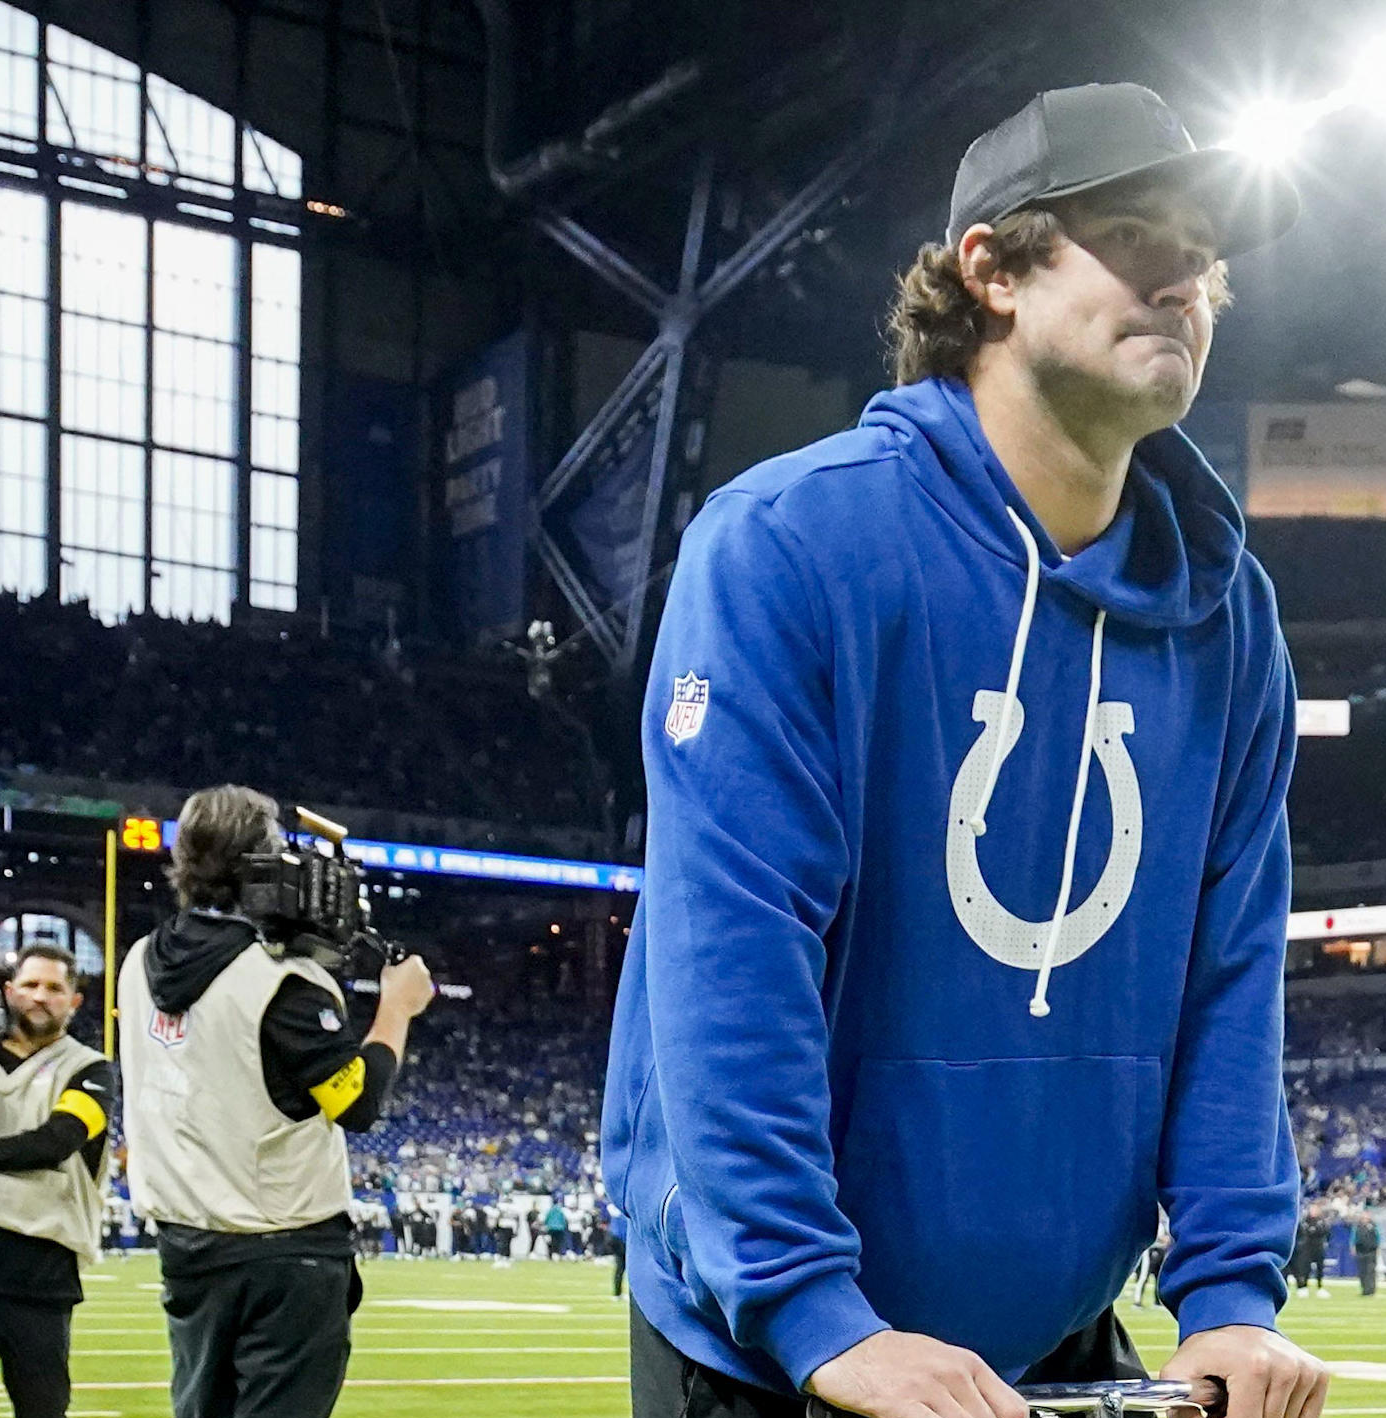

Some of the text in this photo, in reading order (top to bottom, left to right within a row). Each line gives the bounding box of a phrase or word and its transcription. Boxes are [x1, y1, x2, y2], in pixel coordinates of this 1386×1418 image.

[670, 704, 699, 732] NFL
[123, 818, 161, 850] 25
[153, 1009, 185, 1040] NFL
